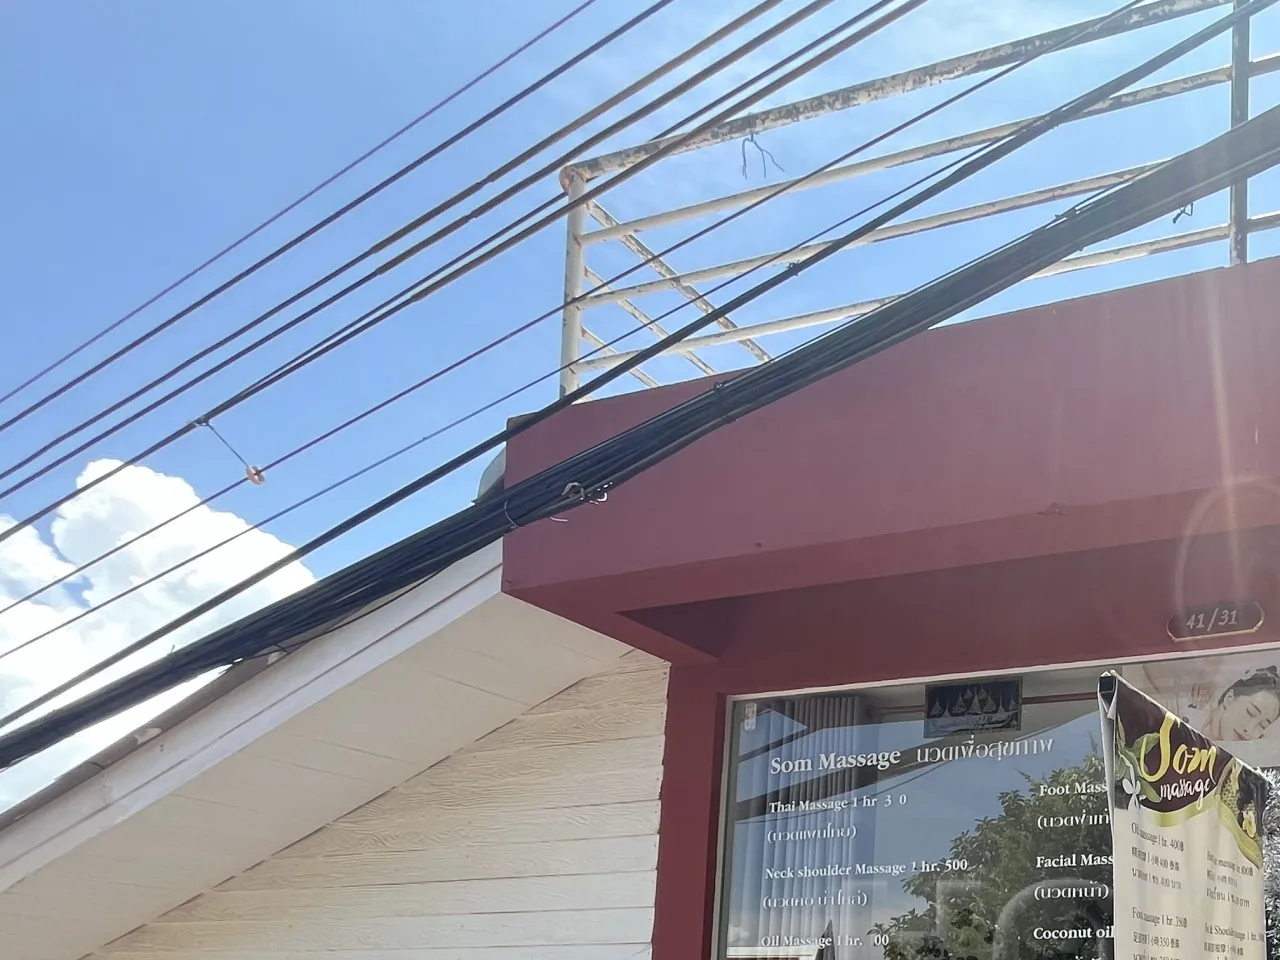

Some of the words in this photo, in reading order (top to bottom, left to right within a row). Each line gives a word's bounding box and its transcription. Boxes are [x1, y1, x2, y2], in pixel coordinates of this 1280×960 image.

[1186, 608, 1237, 631] 41/31
[917, 735, 1053, 762] นวดเพื่อสุขภาพ
[1140, 711, 1217, 785] Som
[770, 757, 812, 775] Som
[819, 750, 901, 771] Massage
[1039, 785, 1069, 797] Foot
[769, 800, 795, 814] Thai
[799, 797, 849, 812] Massage
[863, 795, 878, 807] hr
[765, 867, 794, 879] Neck
[797, 865, 851, 878] shoulder
[855, 863, 906, 876] Massage
[921, 860, 940, 872] hr.
[945, 859, 968, 871] 500
[1036, 854, 1076, 868] Facial
[1034, 881, 1109, 900] (นวดหน้า)
[761, 935, 779, 947] Oil
[783, 935, 832, 949] Massage
[846, 934, 863, 946] hr.
[1033, 927, 1092, 940] Coconut
